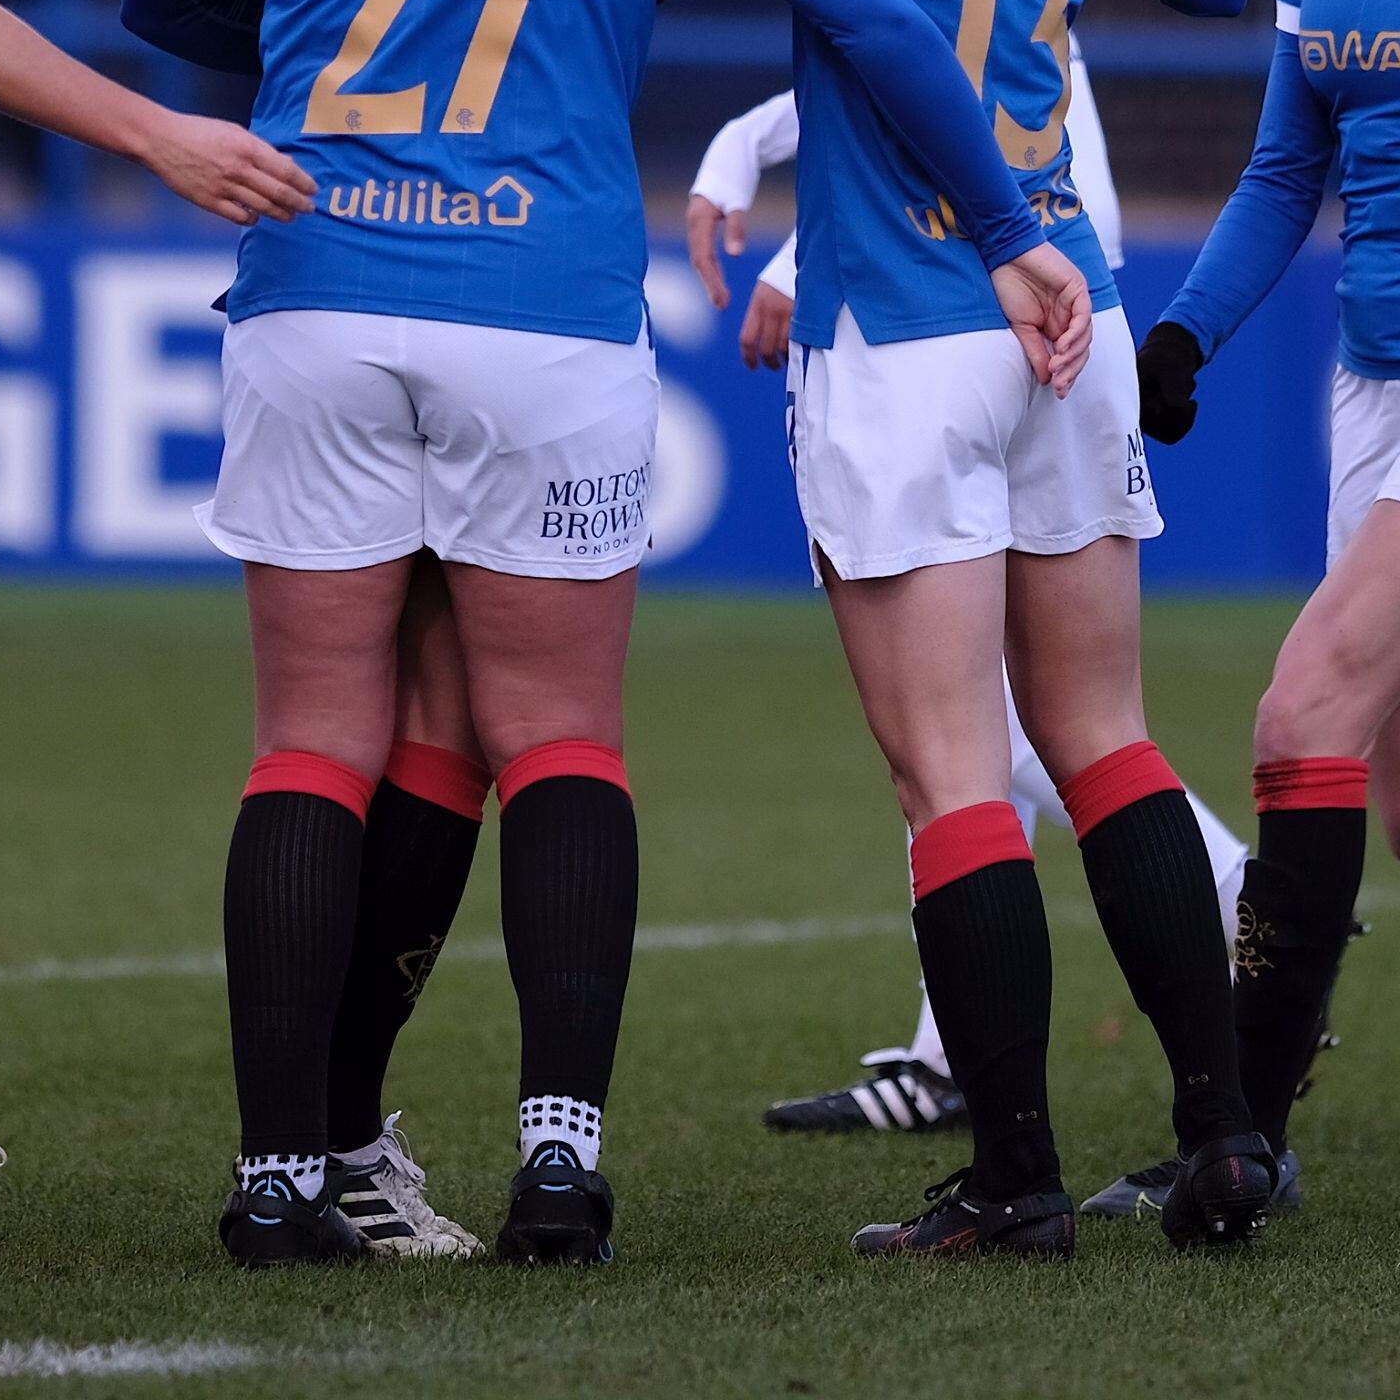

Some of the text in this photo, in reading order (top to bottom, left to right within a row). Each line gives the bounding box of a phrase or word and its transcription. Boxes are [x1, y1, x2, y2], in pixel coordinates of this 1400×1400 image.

[329, 179, 480, 226] utilita
[540, 497, 645, 540] BROWN
[564, 535, 630, 555] LONDON
